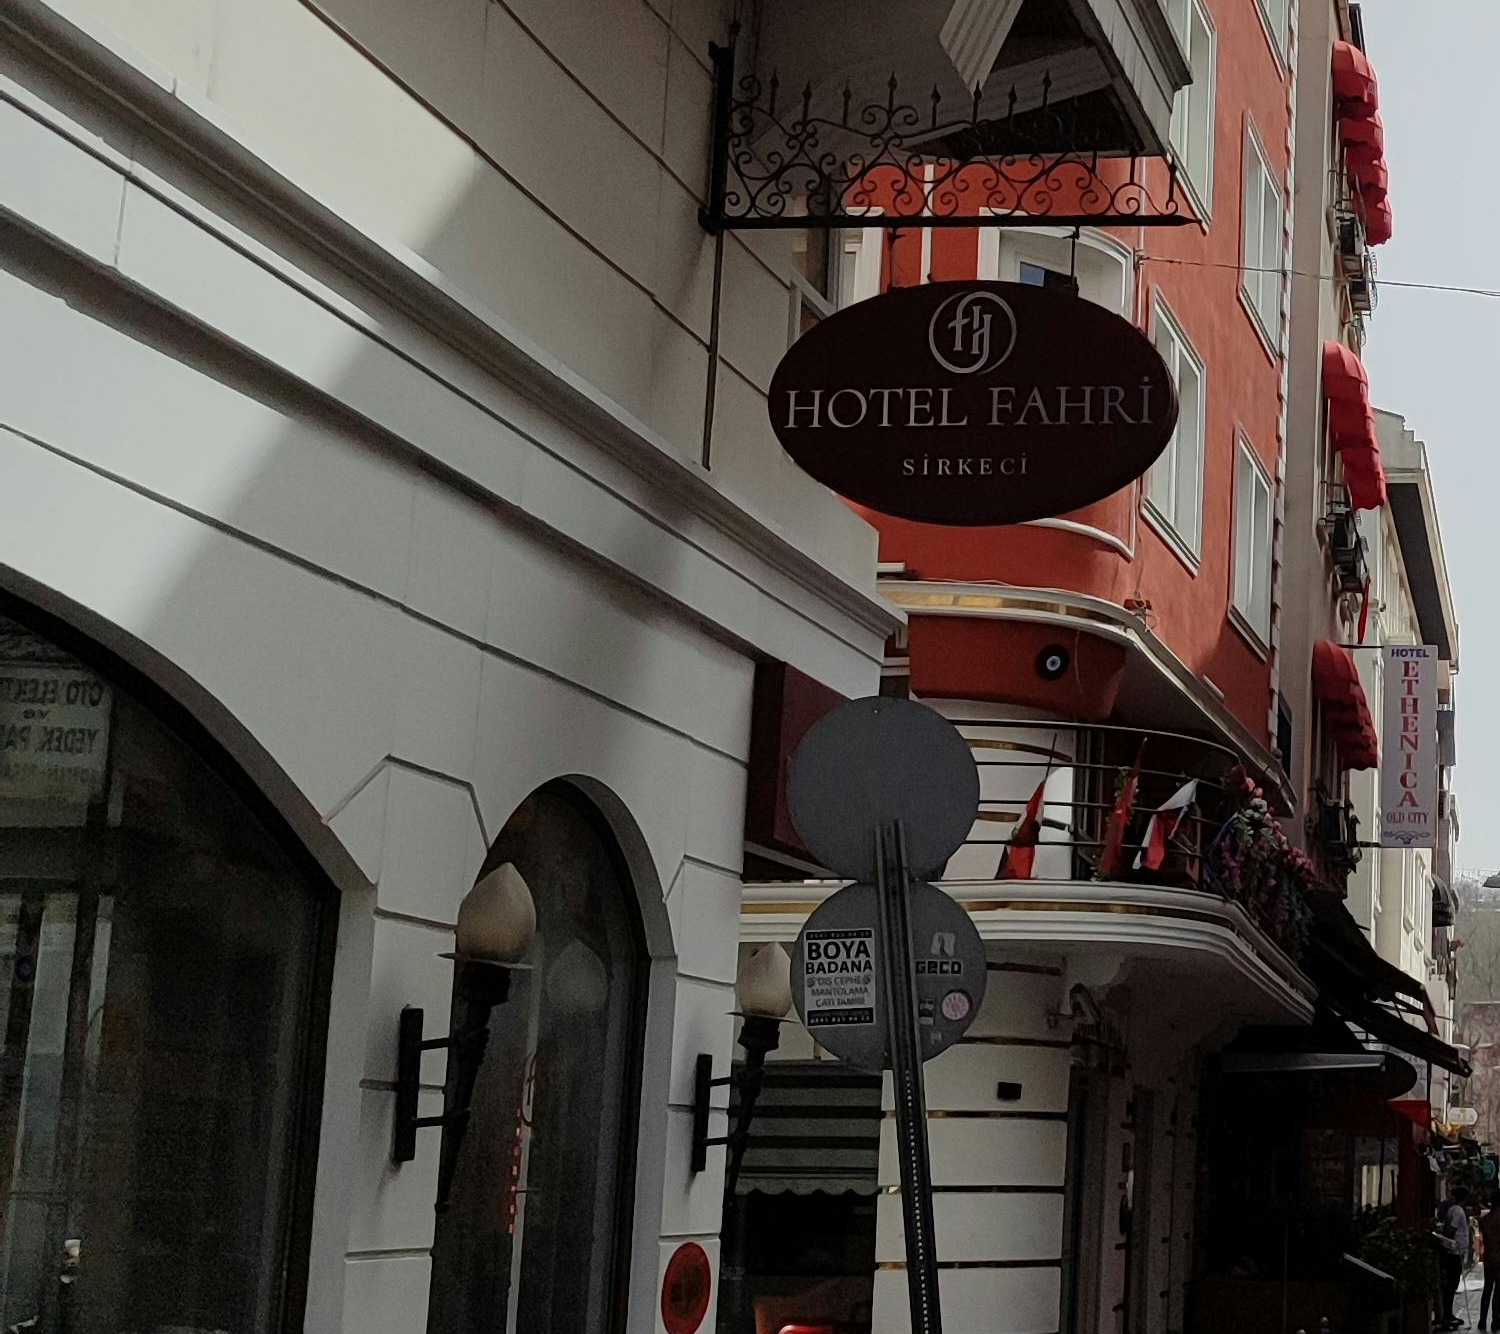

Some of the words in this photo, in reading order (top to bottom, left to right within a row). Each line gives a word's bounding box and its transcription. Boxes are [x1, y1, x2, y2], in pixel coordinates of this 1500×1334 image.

[783, 387, 969, 429] HOTEL
[986, 375, 1155, 427] FAHRİ
[901, 452, 1029, 477] SİRKECİ
[1391, 648, 1429, 658] HOTEL
[1398, 660, 1420, 808] ETHENICA
[1407, 811, 1429, 824] CITY
[807, 940, 871, 960] BOYA
[805, 959, 873, 975] BADANA
